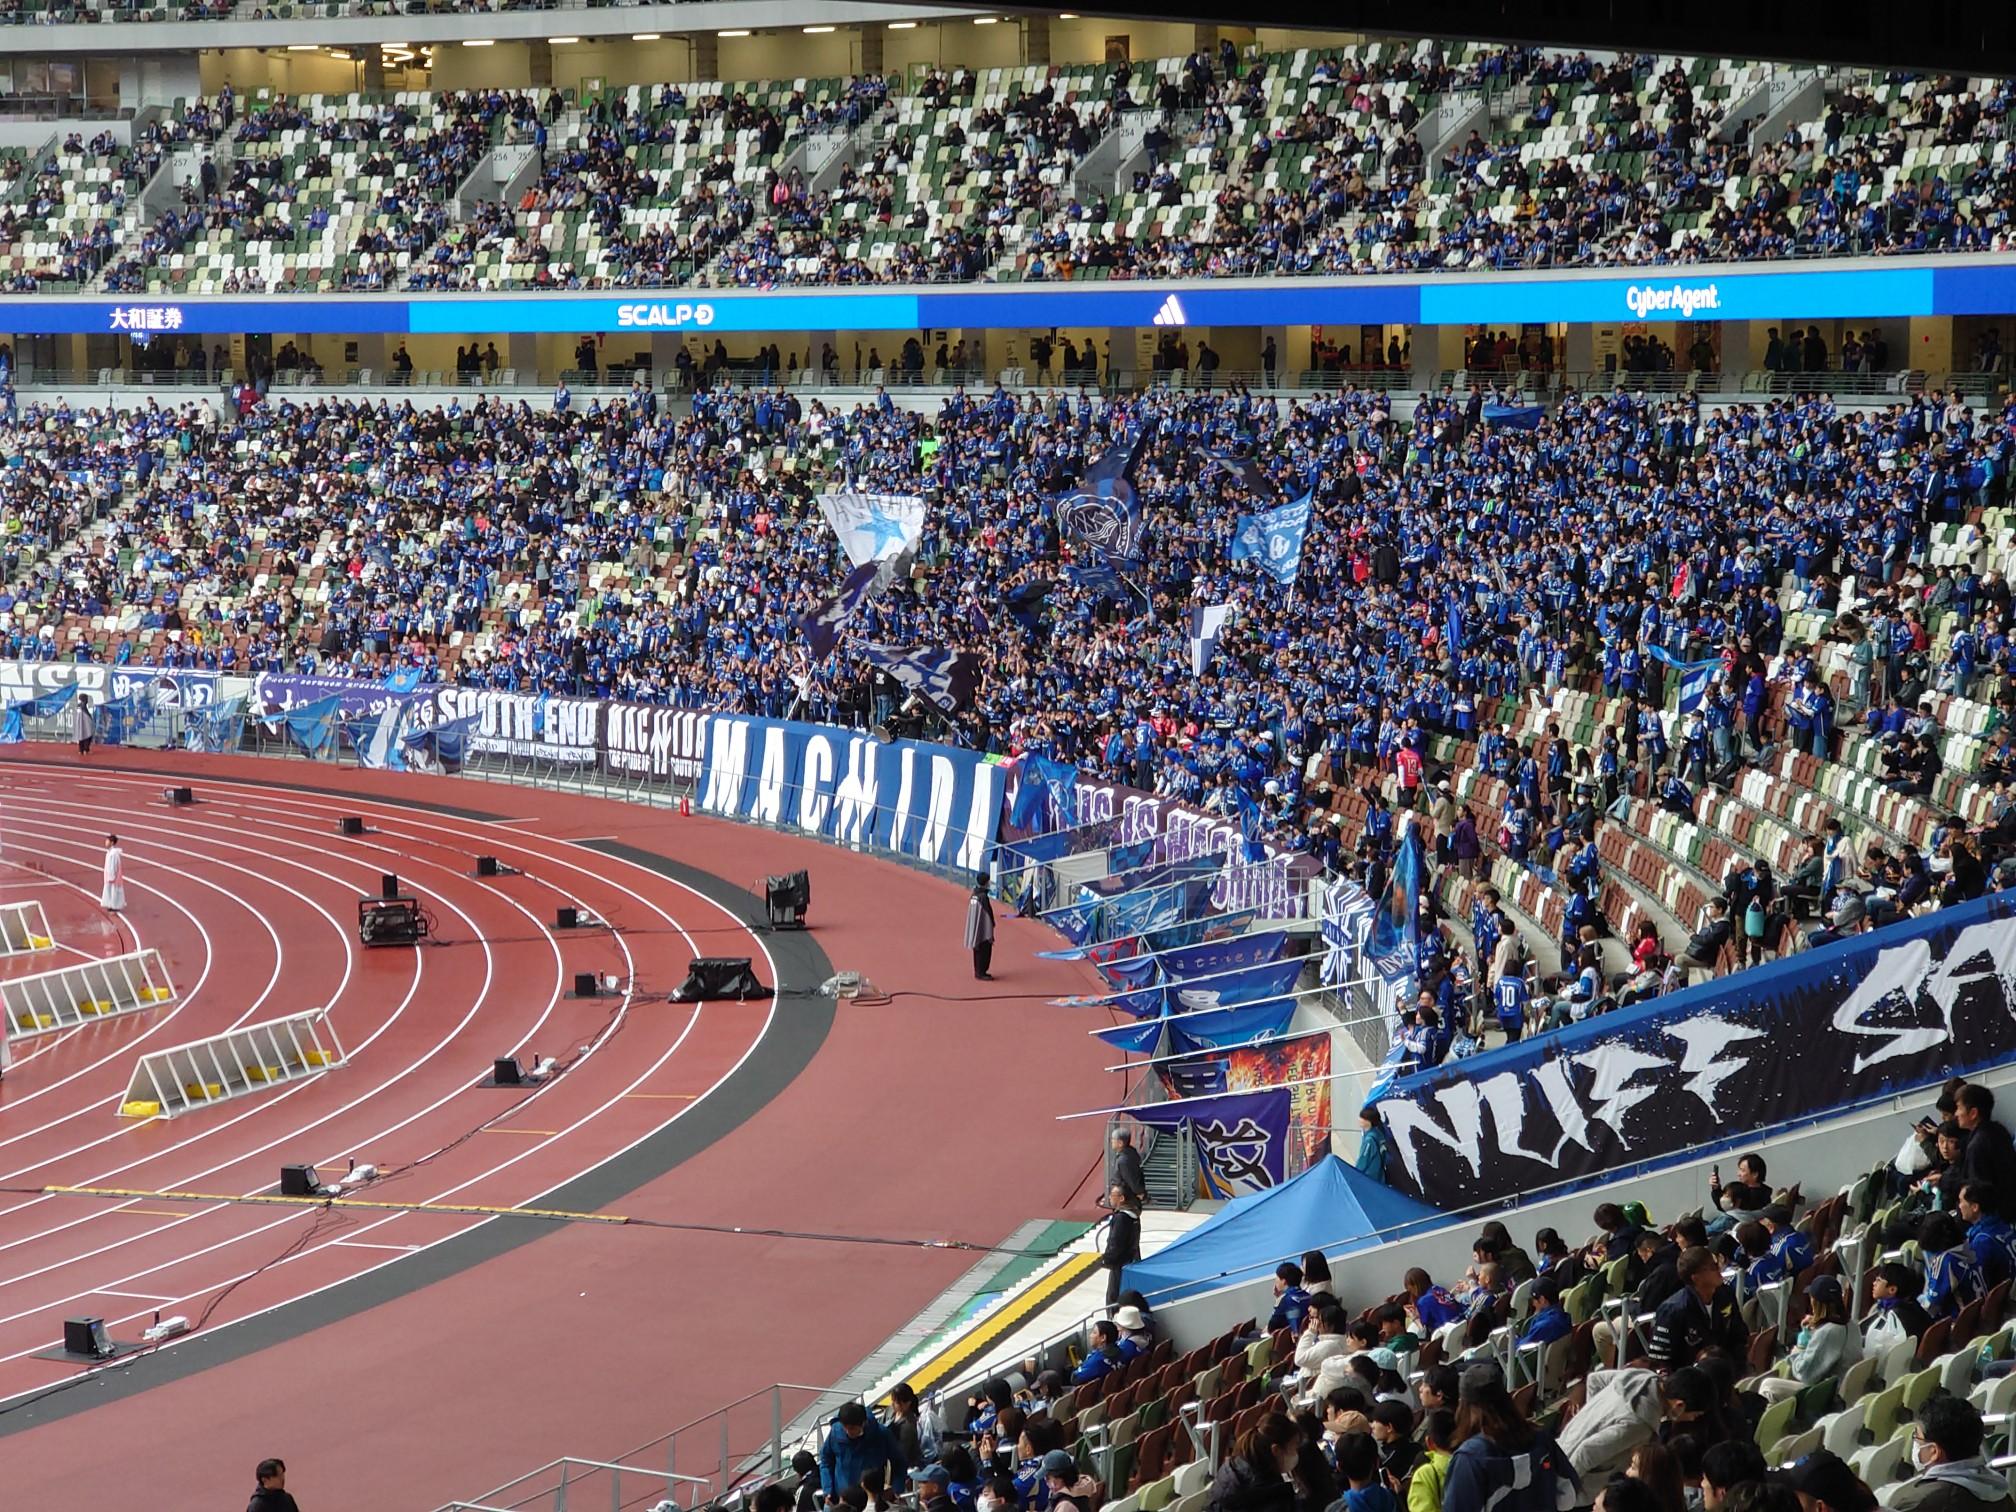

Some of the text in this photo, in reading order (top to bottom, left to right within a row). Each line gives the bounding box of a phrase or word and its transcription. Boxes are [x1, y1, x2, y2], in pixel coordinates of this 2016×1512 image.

[1770, 80, 1785, 92] 252
[173, 159, 188, 168] 257
[493, 152, 507, 160] 256
[109, 307, 183, 329] 大和証券
[617, 304, 692, 326] SCALP
[437, 688, 537, 741] SOUTH
[543, 698, 599, 746] END
[607, 703, 711, 774] MACHIDA
[702, 718, 994, 872] MACHIDA
[1500, 985, 1515, 1007] 10
[1377, 1012, 1768, 1199] NUFF
